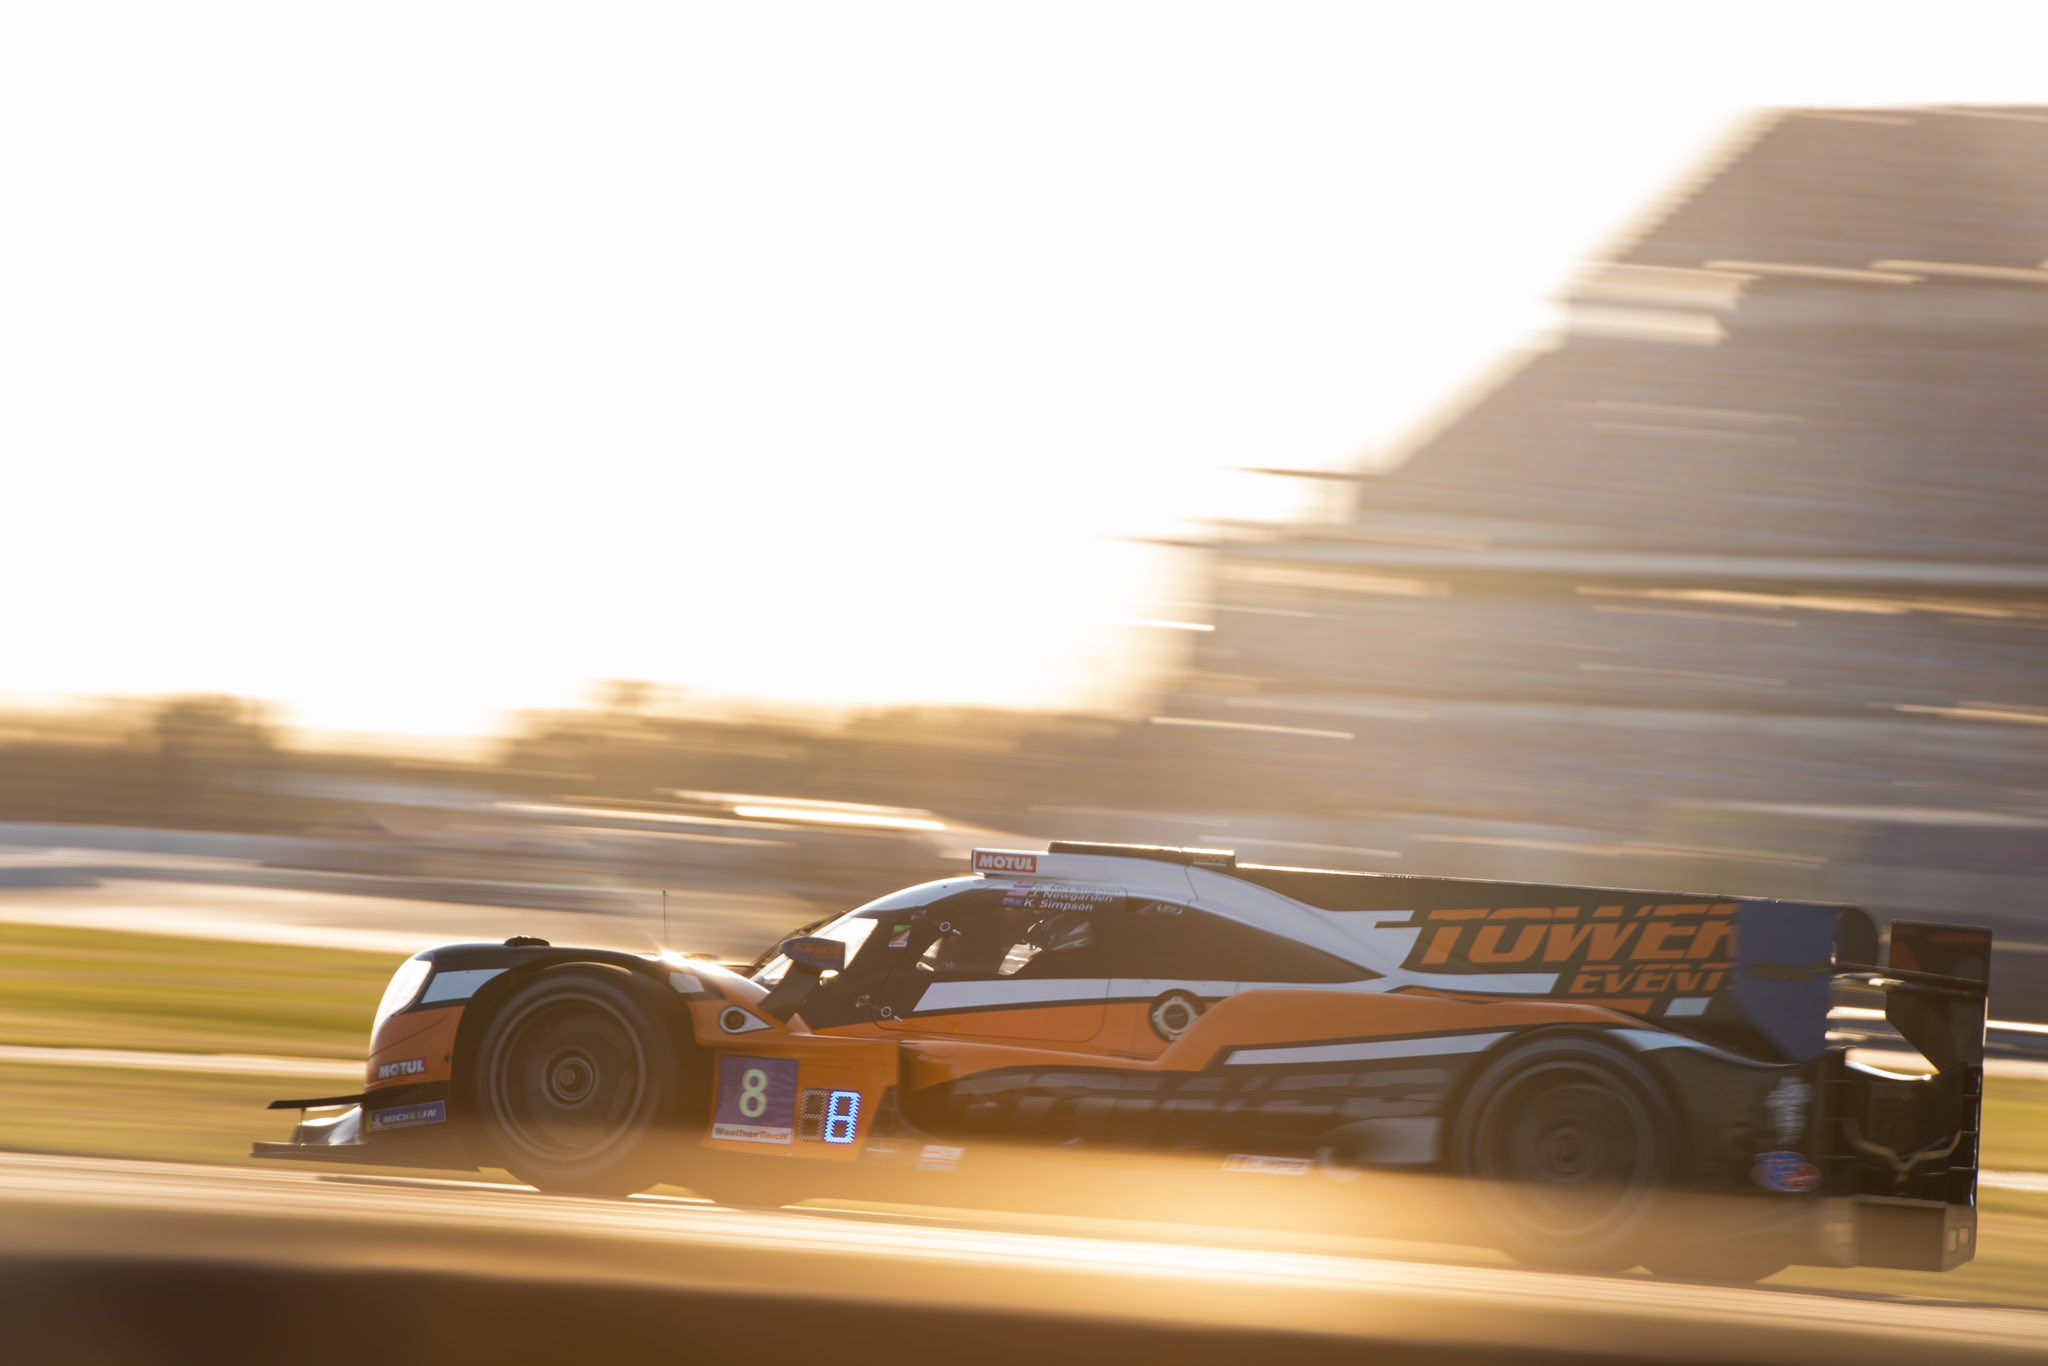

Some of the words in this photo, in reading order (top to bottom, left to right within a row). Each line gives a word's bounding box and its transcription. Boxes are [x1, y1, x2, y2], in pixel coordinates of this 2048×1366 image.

[978, 853, 1034, 871] MOTUL
[1024, 899, 1036, 909] K.
[1039, 899, 1094, 913] Simpson
[1043, 890, 1113, 903] Newgarden
[1568, 962, 1738, 994] EVENT
[378, 1059, 425, 1079] MOTUL
[739, 1068, 768, 1118] 8
[383, 1108, 437, 1124] MICHELIN
[823, 1090, 861, 1144] 8
